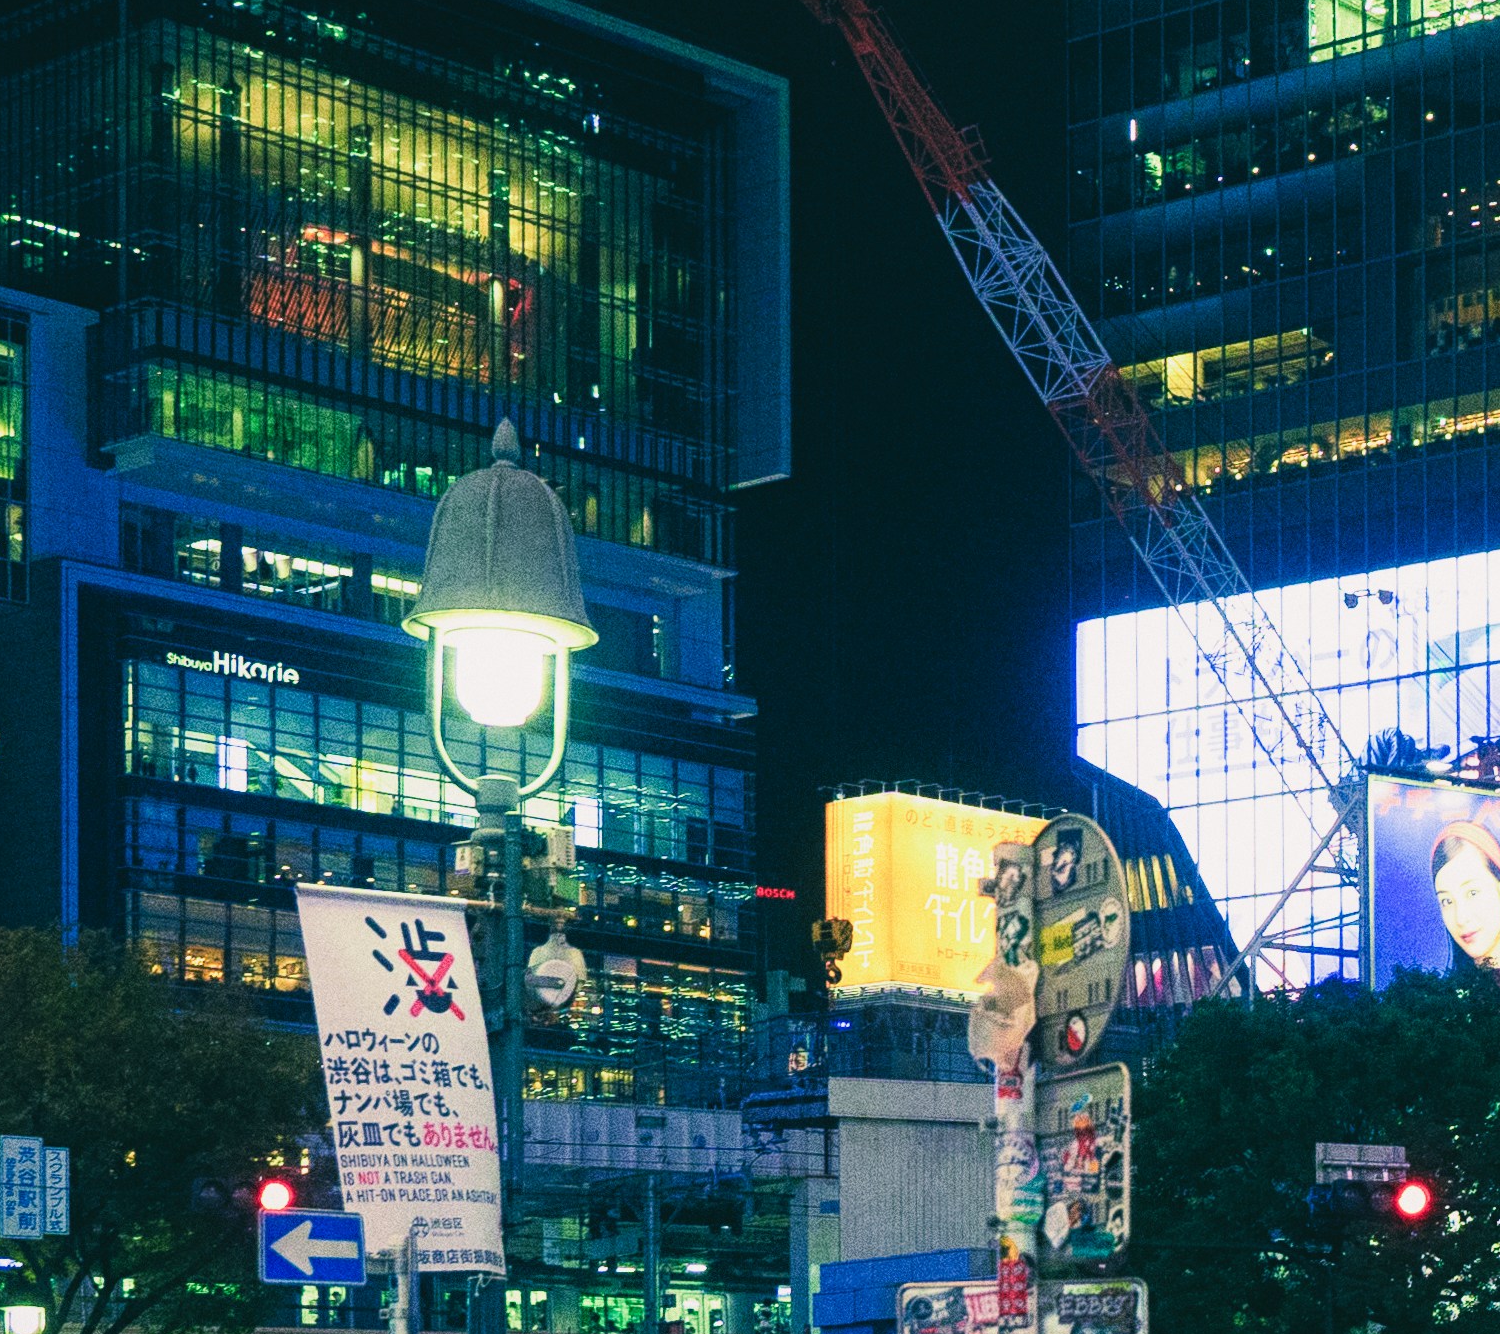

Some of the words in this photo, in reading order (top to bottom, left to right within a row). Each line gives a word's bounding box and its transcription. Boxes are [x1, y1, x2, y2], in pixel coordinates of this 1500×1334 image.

[166, 652, 212, 673] Shibuya
[213, 650, 300, 685] Hikarie
[935, 842, 995, 892] 龍角
[924, 893, 996, 945] ダイレ
[324, 1028, 440, 1056] ハロウィーンの
[326, 1058, 491, 1092] 渋谷は、ゴミ箱でも、
[333, 1090, 460, 1119] ナンパ場でも、
[338, 1121, 500, 1154] 灰皿でもありません。
[340, 1154, 390, 1169] SHIBUYA
[393, 1154, 408, 1168] ON
[411, 1155, 471, 1169] HALLOWEEN
[17, 1145, 37, 1232] 渋谷駅前
[343, 1171, 355, 1186] IS
[358, 1171, 380, 1185] NOT
[383, 1171, 391, 1185] A
[394, 1171, 428, 1185] TRASH
[345, 1190, 354, 1203] A
[357, 1188, 397, 1204] HIT-ON
[451, 1189, 464, 1203] AN
